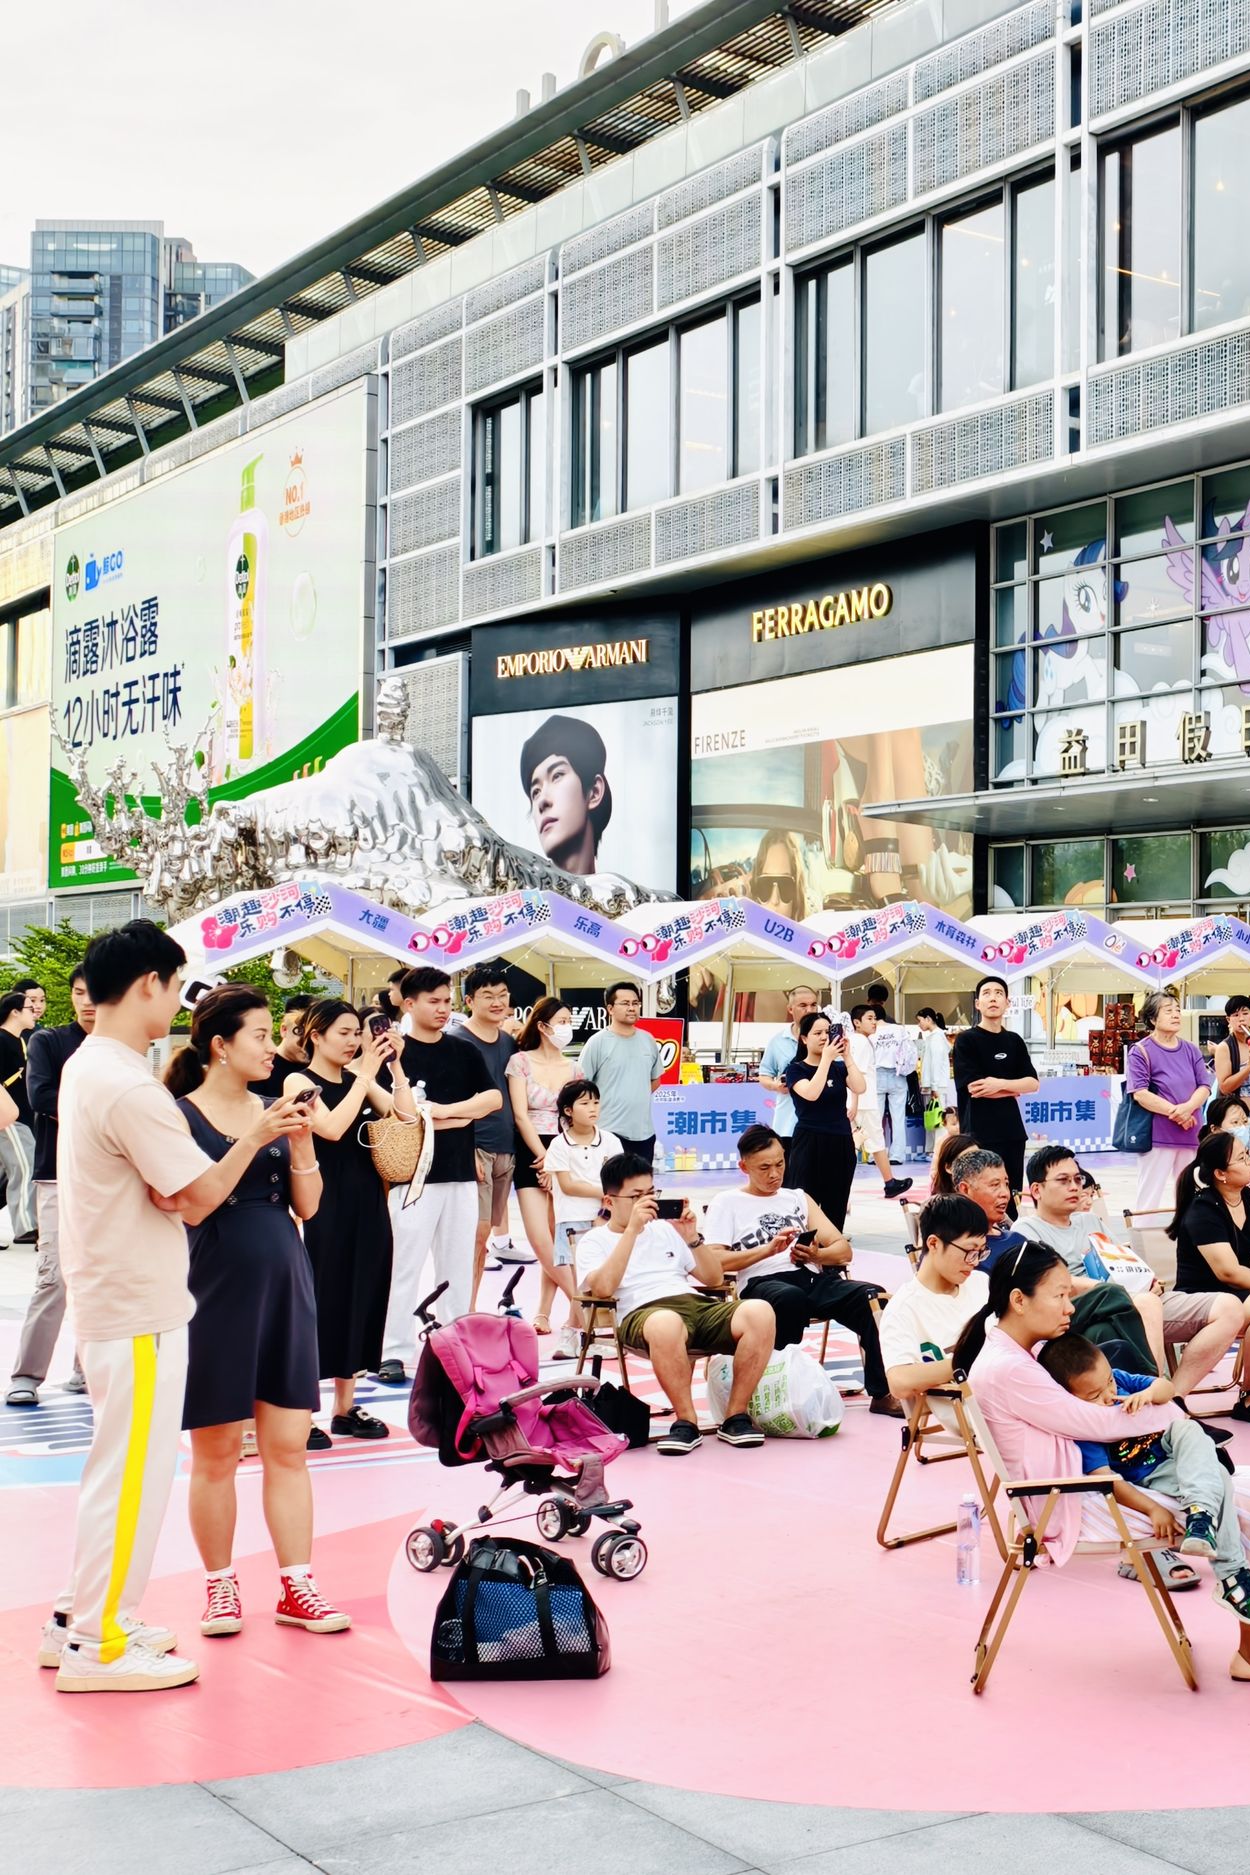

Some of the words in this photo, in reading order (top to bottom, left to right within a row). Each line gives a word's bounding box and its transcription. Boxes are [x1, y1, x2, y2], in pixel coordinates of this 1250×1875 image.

[752, 583, 893, 643] FERRAGAMO
[65, 595, 158, 683] 滴露沐浴露
[497, 648, 566, 679] EMPORIO
[584, 639, 650, 669] ARMANI
[694, 730, 746, 754] FIRENZE
[217, 883, 301, 926] 潮趣沙河
[239, 893, 316, 938] 乐购不停
[359, 908, 391, 932] 大疆
[449, 893, 522, 931] 潮趣沙河
[467, 902, 536, 944] 乐购不停
[656, 902, 721, 940] 潮趣沙河
[845, 906, 905, 940] 潮趣沙河
[574, 915, 603, 938] 乐高
[674, 909, 733, 951] 乐购不停
[764, 918, 795, 943] U2B
[861, 912, 915, 949] 乐购不停
[667, 1110, 756, 1135] 潮市集
[1025, 1100, 1095, 1123] 潮市集
